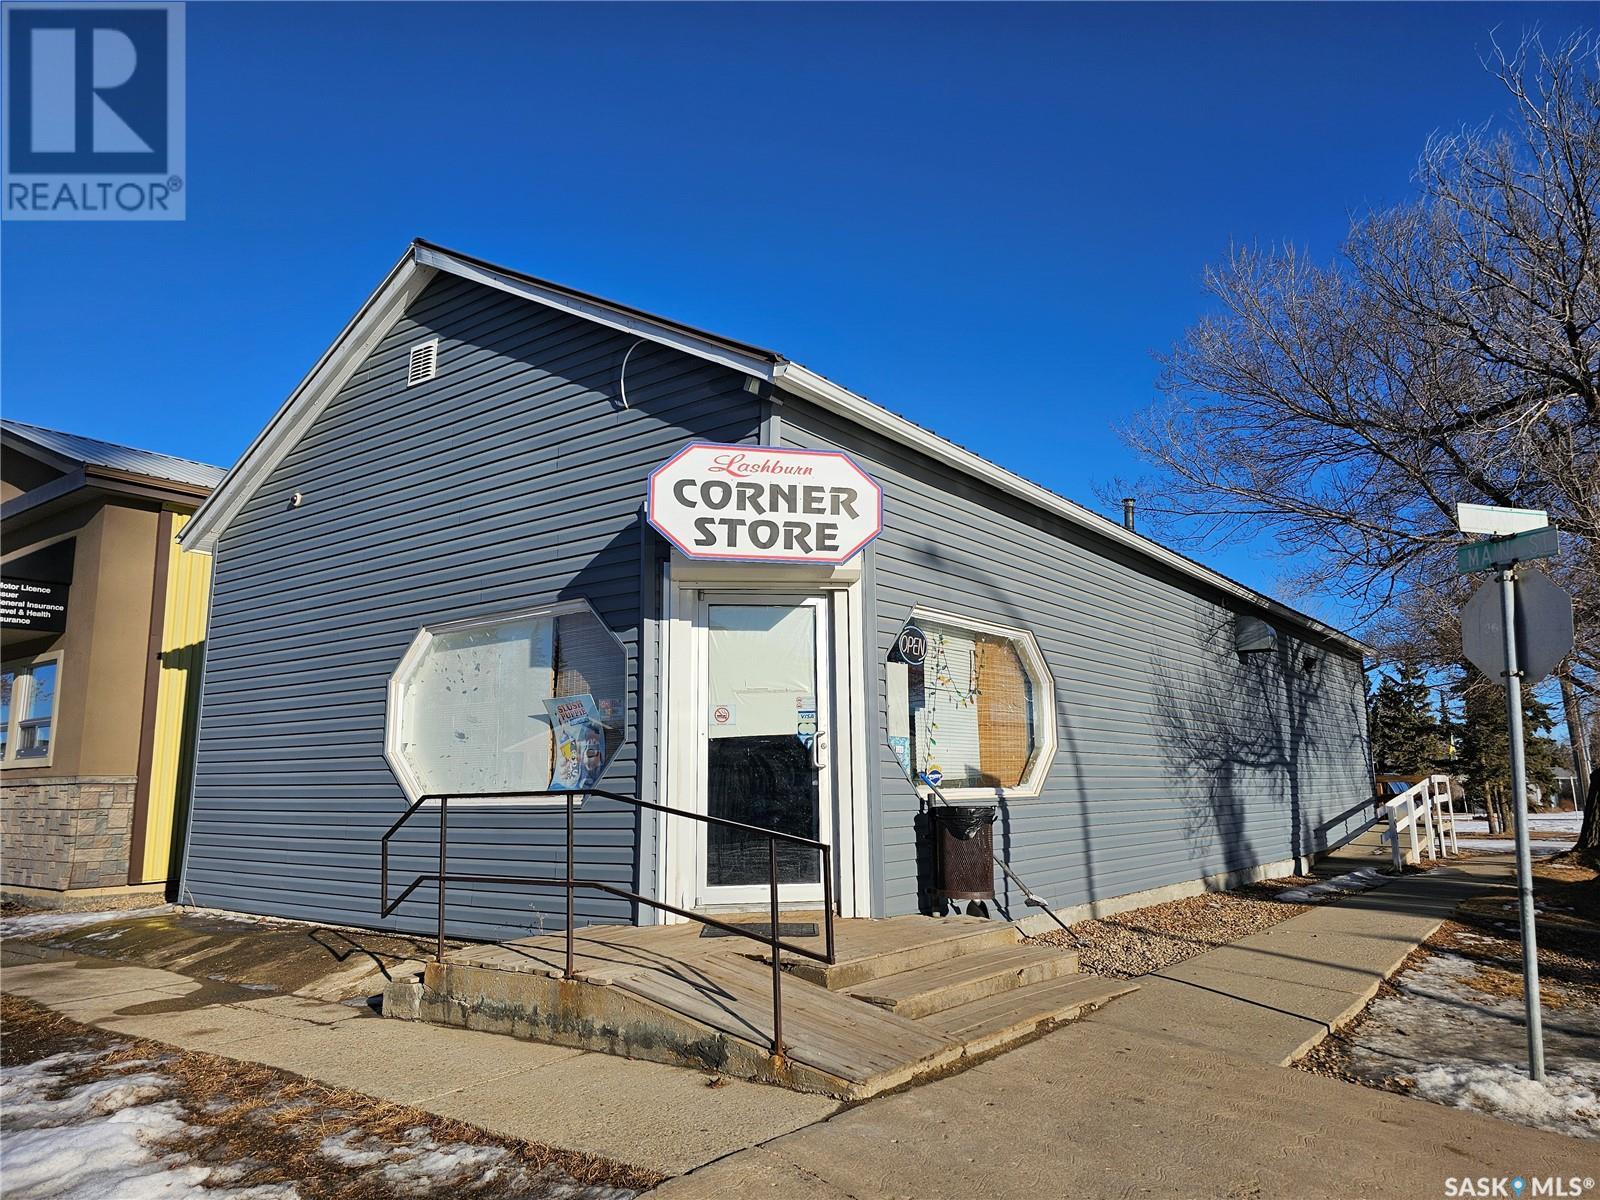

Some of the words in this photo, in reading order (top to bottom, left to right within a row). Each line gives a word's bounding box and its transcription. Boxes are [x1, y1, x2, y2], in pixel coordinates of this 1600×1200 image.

[708, 454, 814, 478] Lashburn
[673, 479, 860, 520] CORNER
[693, 517, 840, 555] STORE
[21, 584, 51, 594] Licence
[0, 599, 25, 608] eneral
[27, 601, 64, 611] Insurance
[26, 610, 51, 618] Health
[901, 635, 926, 657] OPEN
[557, 700, 584, 714] SLUSH
